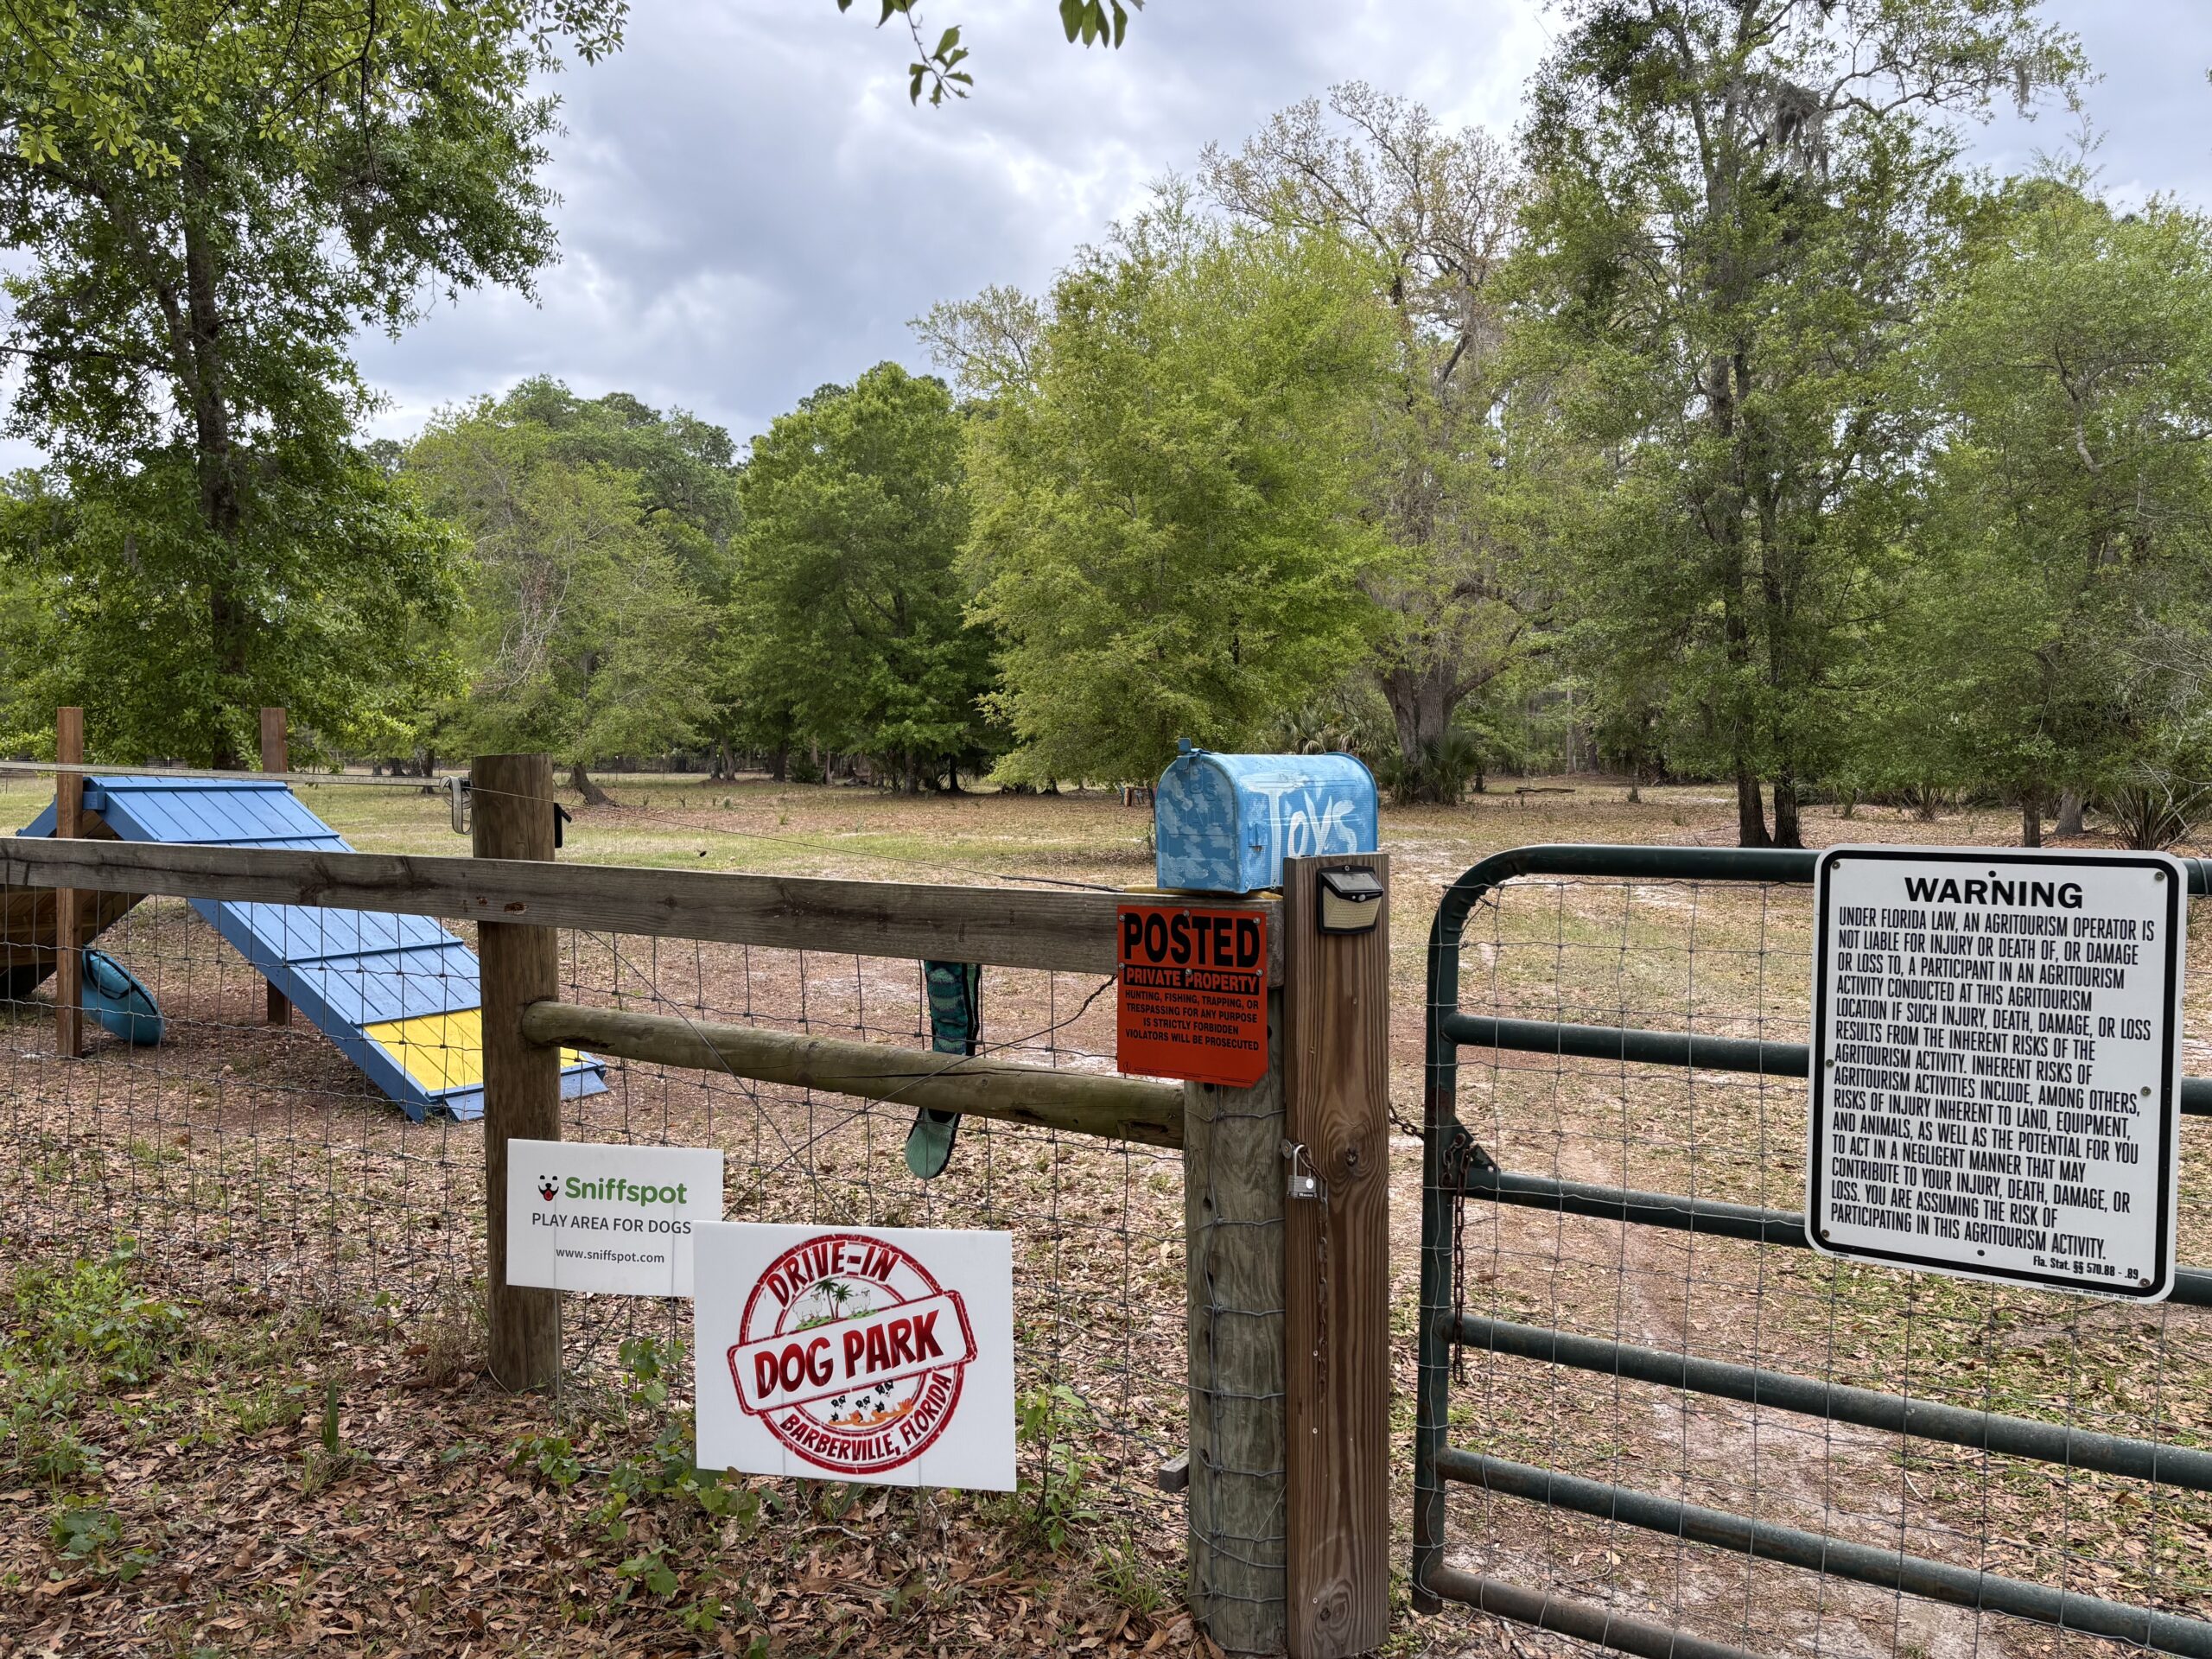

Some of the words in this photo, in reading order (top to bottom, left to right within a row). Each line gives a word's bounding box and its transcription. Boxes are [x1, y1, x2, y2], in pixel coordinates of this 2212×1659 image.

[1904, 877, 2083, 909] WARNING
[1124, 912, 1260, 968] POSTED
[1839, 906, 1876, 927] UNDER
[1881, 908, 1926, 930] FLORIDA
[1931, 911, 1958, 933] LAW,
[1963, 912, 1980, 932] AN
[1984, 912, 2068, 937] AGRITOURISM
[2073, 917, 2136, 940] OPERATOR
[2142, 920, 2154, 941] IS
[1838, 929, 1860, 949] NOT
[1864, 930, 1899, 951] LIABLE
[1904, 932, 1925, 953] FOR
[1930, 934, 1974, 956] INJURY
[1977, 936, 1993, 957] OR
[1999, 938, 2035, 959] DEATH
[2041, 939, 2058, 963] OF,
[2064, 940, 2081, 962] OR
[2086, 942, 2139, 965] DAMAGE
[1126, 967, 1181, 987] PRIVATE
[1185, 972, 1257, 993] PROPERTY
[1838, 951, 1852, 971] OR
[1857, 953, 1883, 974] LOSS
[1887, 955, 1904, 977] TO,
[1908, 956, 1916, 976] A
[1921, 957, 1995, 981] PARTICIPANT
[1999, 961, 2012, 982] IN
[2017, 963, 2034, 983] AN
[2038, 963, 2124, 989] AGRITOURISM
[1125, 989, 1162, 1002] HUNTING,
[1164, 992, 1199, 1005] FISHING,
[1201, 995, 1244, 1010] TRAPPING,
[1246, 999, 1259, 1010] OR
[1126, 1002, 1180, 1016] TRESPASSING
[1182, 1007, 1198, 1018] FOR
[1200, 1008, 1217, 1019] ANY
[1218, 1010, 1257, 1023] PURPOSE
[1836, 974, 1884, 996] ACTIVITY
[1887, 977, 1955, 1001] CONDUCTED
[1959, 982, 1973, 1003] AT
[1976, 983, 2003, 1005] THIS
[2007, 986, 2092, 1012] AGRITOURISM
[1143, 1017, 1151, 1027] IS
[1153, 1017, 1191, 1030] STRICTLY
[1193, 1020, 1239, 1035] FORBIDDEN
[1836, 997, 1887, 1020] LOCATION
[1891, 1001, 1902, 1020] IF
[1906, 1002, 1936, 1024] SUCH
[1942, 1005, 1987, 1030] INJURY,
[1993, 1008, 2032, 1033] DEATH,
[2038, 1012, 2093, 1039] DAMAGE,
[2098, 1016, 2115, 1038] OR
[2120, 1018, 2151, 1040] LOSS
[1125, 1028, 1169, 1041] VIOLATORS
[1171, 1033, 1190, 1044] WILL
[1192, 1034, 1203, 1045] BE
[1205, 1035, 1259, 1051] PROSECUTED
[1835, 1020, 1882, 1043] RESULTS
[1886, 1024, 1918, 1046] FROM
[1923, 1027, 1944, 1048] THE
[1949, 1029, 2008, 1053] INHERENT
[2012, 1034, 2048, 1057] RISKS
[2053, 1037, 2069, 1058] OF
[2073, 1039, 2095, 1061] THE
[1834, 1043, 1910, 1068] AGRITOURISM
[1915, 1050, 1967, 1074] ACTIVITY.
[1972, 1054, 2032, 1079] INHERENT
[2036, 1060, 2072, 1084] RISKS
[2077, 1064, 2093, 1085] OF
[1834, 1065, 1910, 1091] AGRITOURISM
[1914, 1073, 1975, 1098] ACTIVITIES
[1980, 1079, 2033, 1106] INCLUDE,
[2037, 1084, 2084, 1109] AMONG
[2089, 1090, 2139, 1116] OTHERS,
[1834, 1088, 1866, 1110] RISKS
[1870, 1091, 1884, 1112] OF
[1889, 1094, 1930, 1117] INJURY
[1935, 1098, 1993, 1123] INHERENT
[1997, 1104, 2012, 1126] TO
[2017, 1107, 2050, 1132] LAND,
[2056, 1110, 2130, 1141] EQUIPMENT,
[1833, 1111, 1855, 1132] AND
[1859, 1114, 1913, 1141] ANIMALS,
[1917, 1121, 1932, 1141] AS
[1937, 1122, 1967, 1145] WELL
[1972, 1126, 1986, 1147] AS
[1991, 1128, 2013, 1150] THE
[2018, 1131, 2082, 1158] POTENTIAL
[2086, 1138, 2109, 1161] FOR
[2114, 1141, 2139, 1164] YOU
[1833, 1134, 1845, 1154] TO
[1849, 1135, 1870, 1157] ACT
[1873, 1138, 1885, 1159] IN
[1890, 1141, 1897, 1160] A
[1903, 1141, 1965, 1168] NEGLIGENT
[1969, 1149, 2021, 1175] MANNER
[2025, 1156, 2055, 1179] THAT
[2059, 1160, 2086, 1183] MAY
[564, 1176, 688, 1207] Sniffspot
[1831, 1179, 1860, 1202] LOSS.
[1865, 1184, 1885, 1205] YOU
[1890, 1187, 1912, 1209] ARE
[1916, 1191, 1979, 1218] ASSUMING
[1983, 1199, 2005, 1222] THE
[2010, 1203, 2037, 1226] RISK
[2043, 1206, 2057, 1228] OF
[1832, 1156, 1899, 1184] CONTRIBUTE
[1903, 1165, 1916, 1186] TO
[1922, 1167, 1951, 1191] YOUR
[1956, 1172, 2002, 1199] INJURY,
[2007, 1178, 2047, 1205] DEATH,
[2053, 1184, 2107, 1212] DAMAGE,
[2113, 1191, 2130, 1213] OR
[532, 1212, 568, 1228] PLAY
[570, 1215, 609, 1231] AREA
[613, 1217, 644, 1232] FOR
[648, 1219, 691, 1235] DOGS
[1831, 1202, 1911, 1232] PARTICIPATING
[1916, 1214, 1929, 1235] IN
[1933, 1217, 1960, 1239] THIS
[1964, 1221, 2046, 1251] AGRITOURISM
[2051, 1232, 2106, 1260] ACTIVITY.
[556, 1249, 665, 1264] www.sniffspot.com
[766, 1240, 899, 1307] DRIVE-IN
[2033, 1255, 2048, 1268] Fla.
[2050, 1257, 2070, 1270] Stat.
[2086, 1262, 2115, 1277] 570.88
[2124, 1268, 2139, 1280] .89
[753, 1336, 834, 1400] DOG
[842, 1309, 944, 1379] PARK
[779, 1413, 902, 1462] BARBERVILLE,
[899, 1371, 952, 1447] FLORIDA
